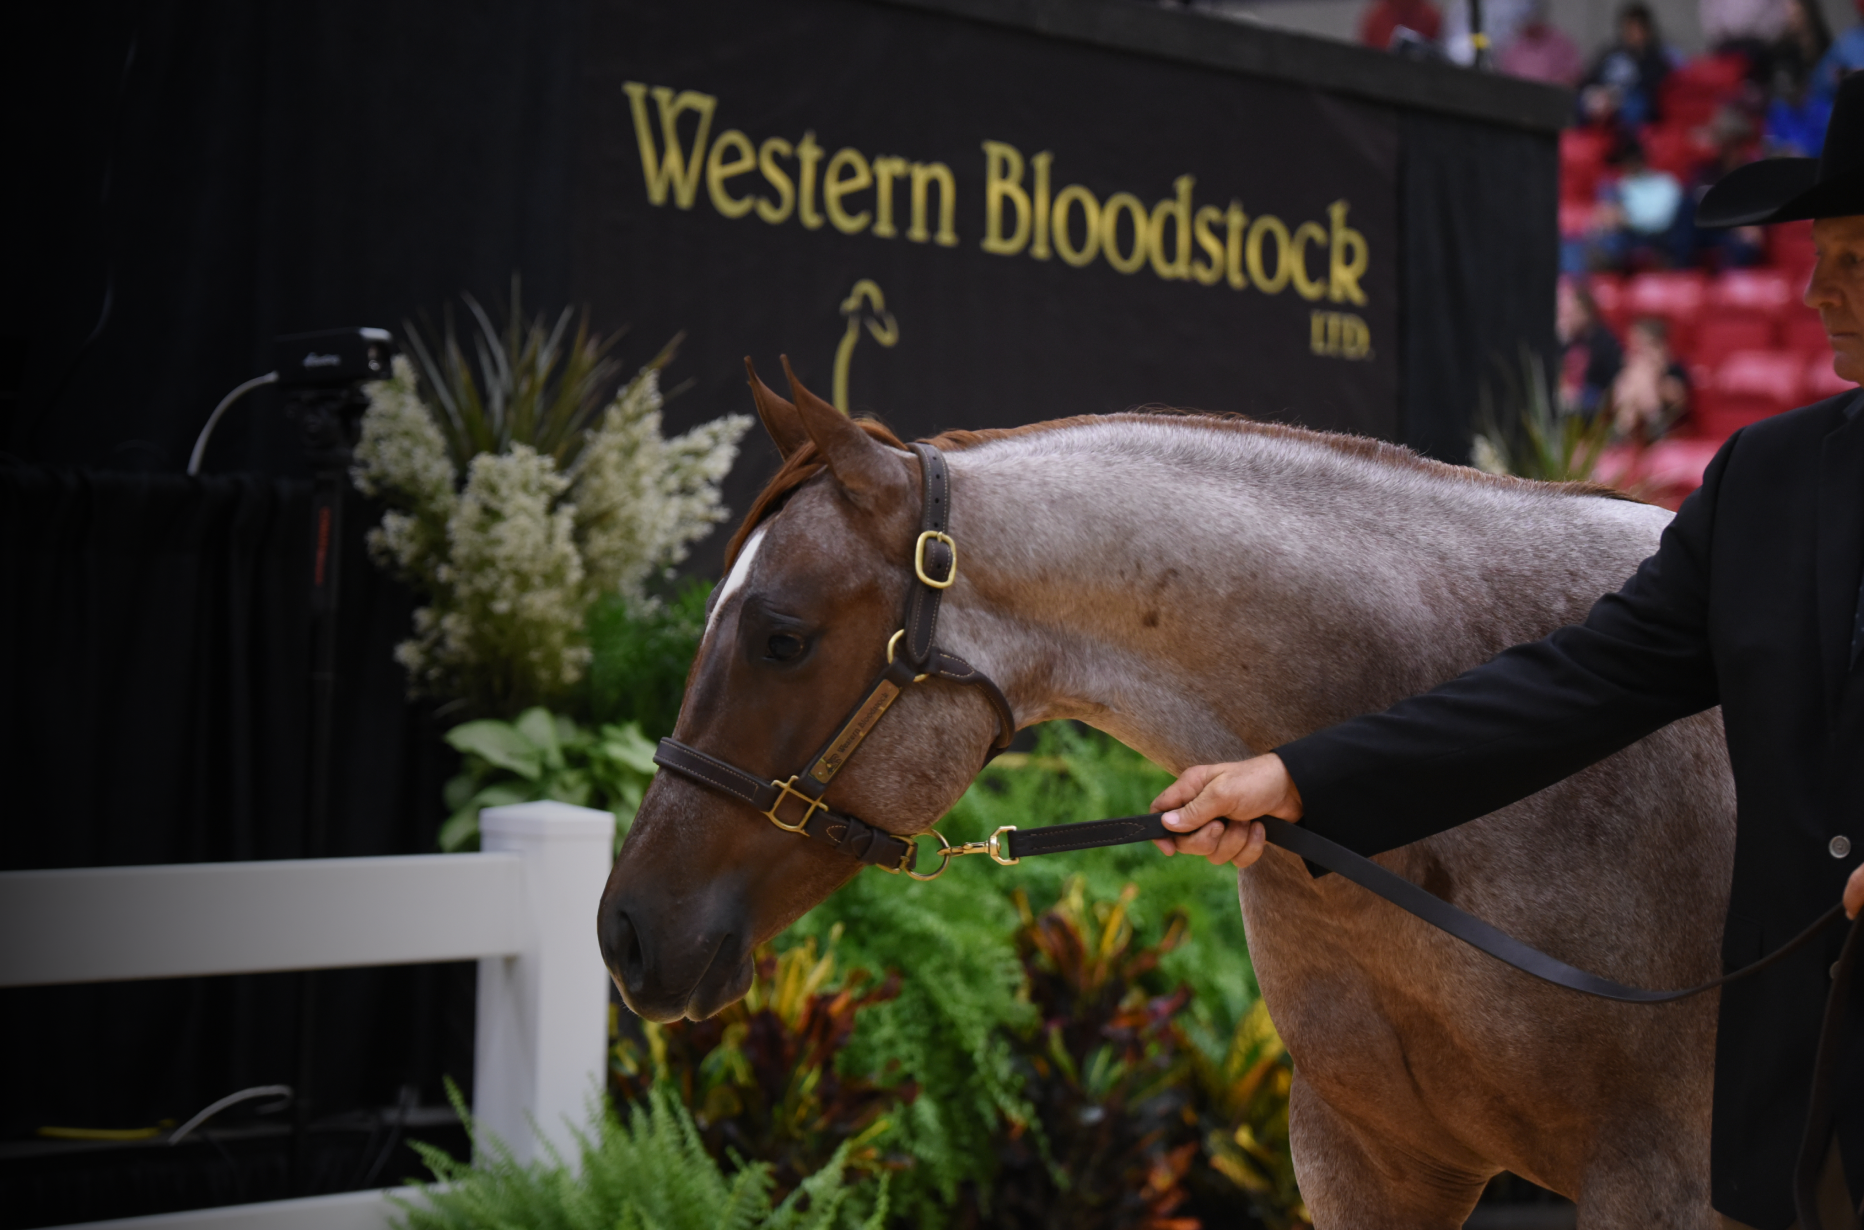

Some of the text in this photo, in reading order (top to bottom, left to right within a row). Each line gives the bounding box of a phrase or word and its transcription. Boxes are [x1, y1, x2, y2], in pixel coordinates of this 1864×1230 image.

[622, 80, 1370, 308] Western Bloodstock
[837, 692, 889, 753] Western Bloodstock
